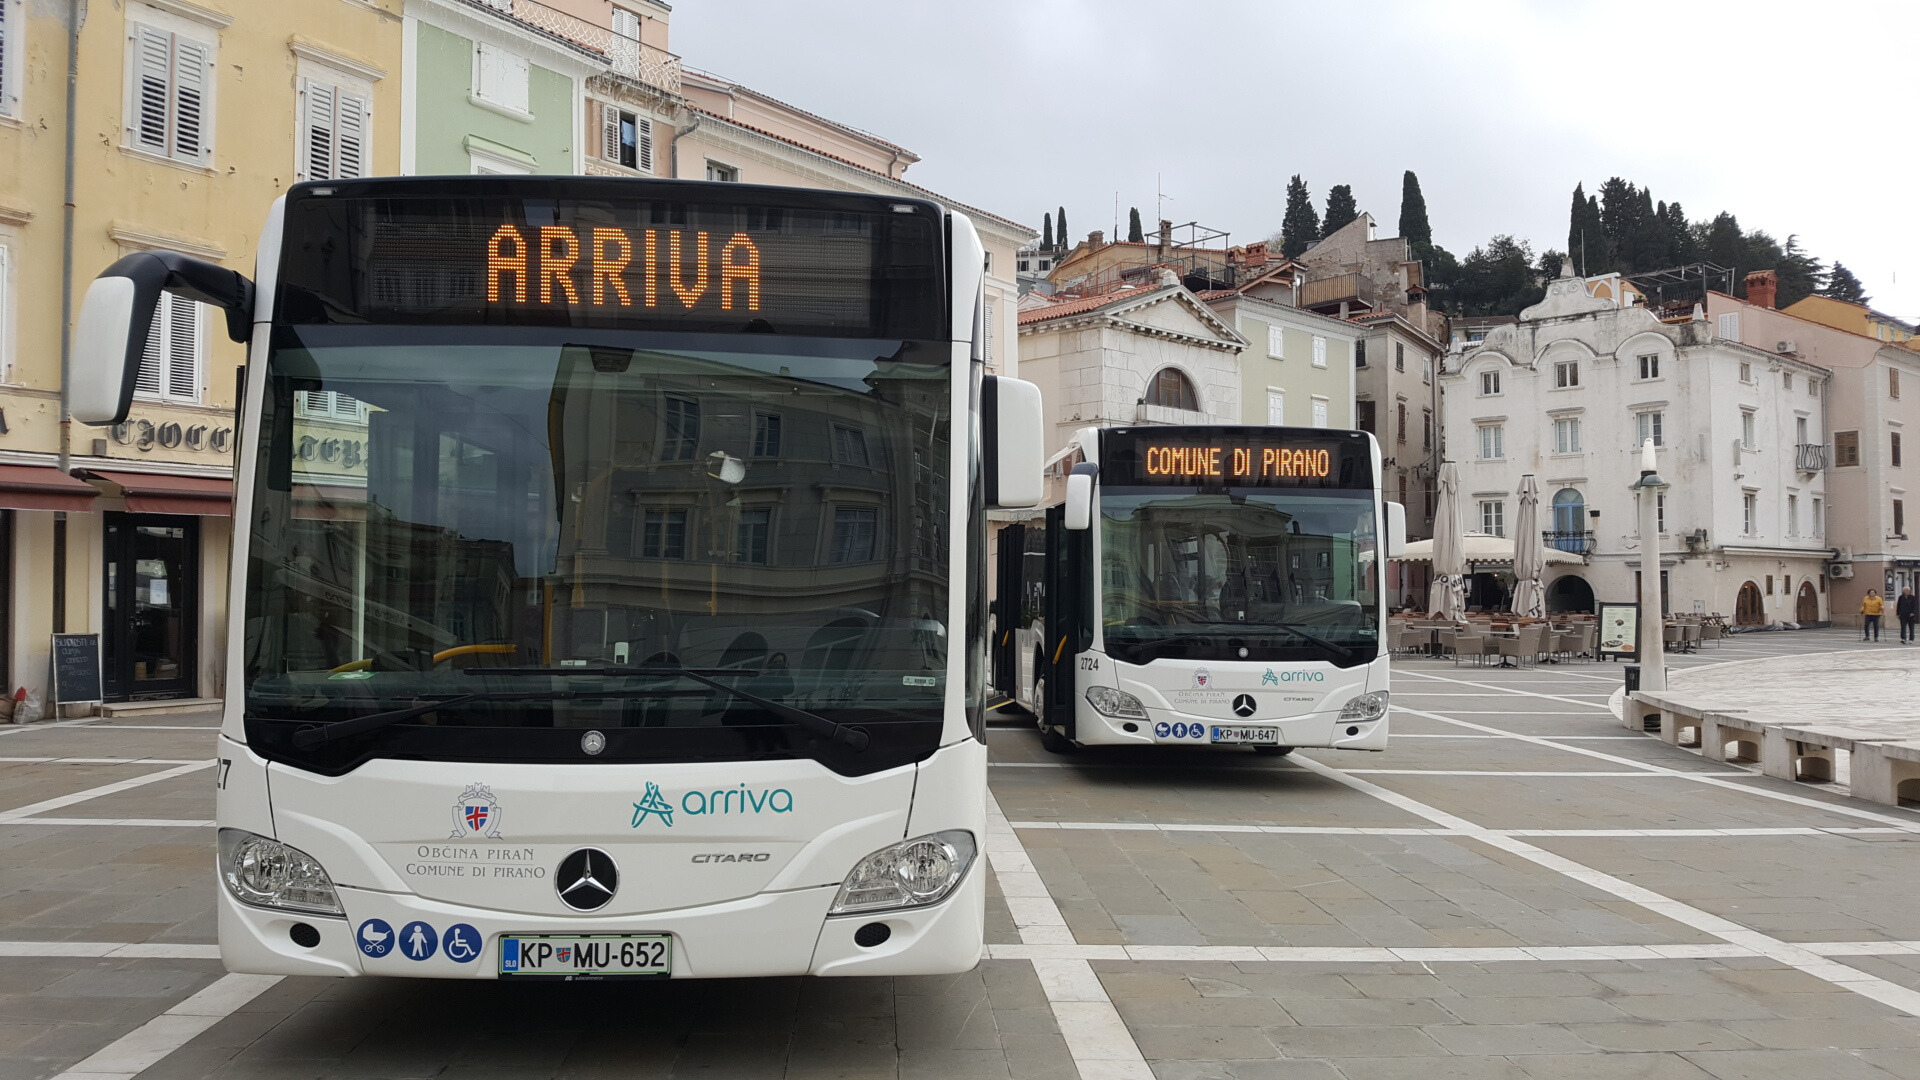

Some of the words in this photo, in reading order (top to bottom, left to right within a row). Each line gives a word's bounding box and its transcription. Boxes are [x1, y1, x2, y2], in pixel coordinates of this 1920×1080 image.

[488, 224, 760, 311] ARRIVA
[1147, 446, 1221, 476] COMUNE
[1233, 448, 1250, 476] DI
[1263, 448, 1330, 478] PIRANO
[1080, 656, 1099, 671] 2724
[1281, 669, 1324, 682] arriva
[1219, 729, 1233, 740] KP
[1240, 729, 1276, 741] MU-647
[681, 782, 793, 816] arriva
[417, 845, 479, 860] OBČINA
[487, 848, 534, 861] PIRAN
[691, 852, 771, 864] CITARO
[406, 863, 465, 877] COMUNE
[472, 866, 486, 877] DI
[494, 866, 546, 879] PIRANO
[504, 960, 517, 968] SLO
[520, 942, 553, 968] KP
[573, 941, 666, 969] MU-652
